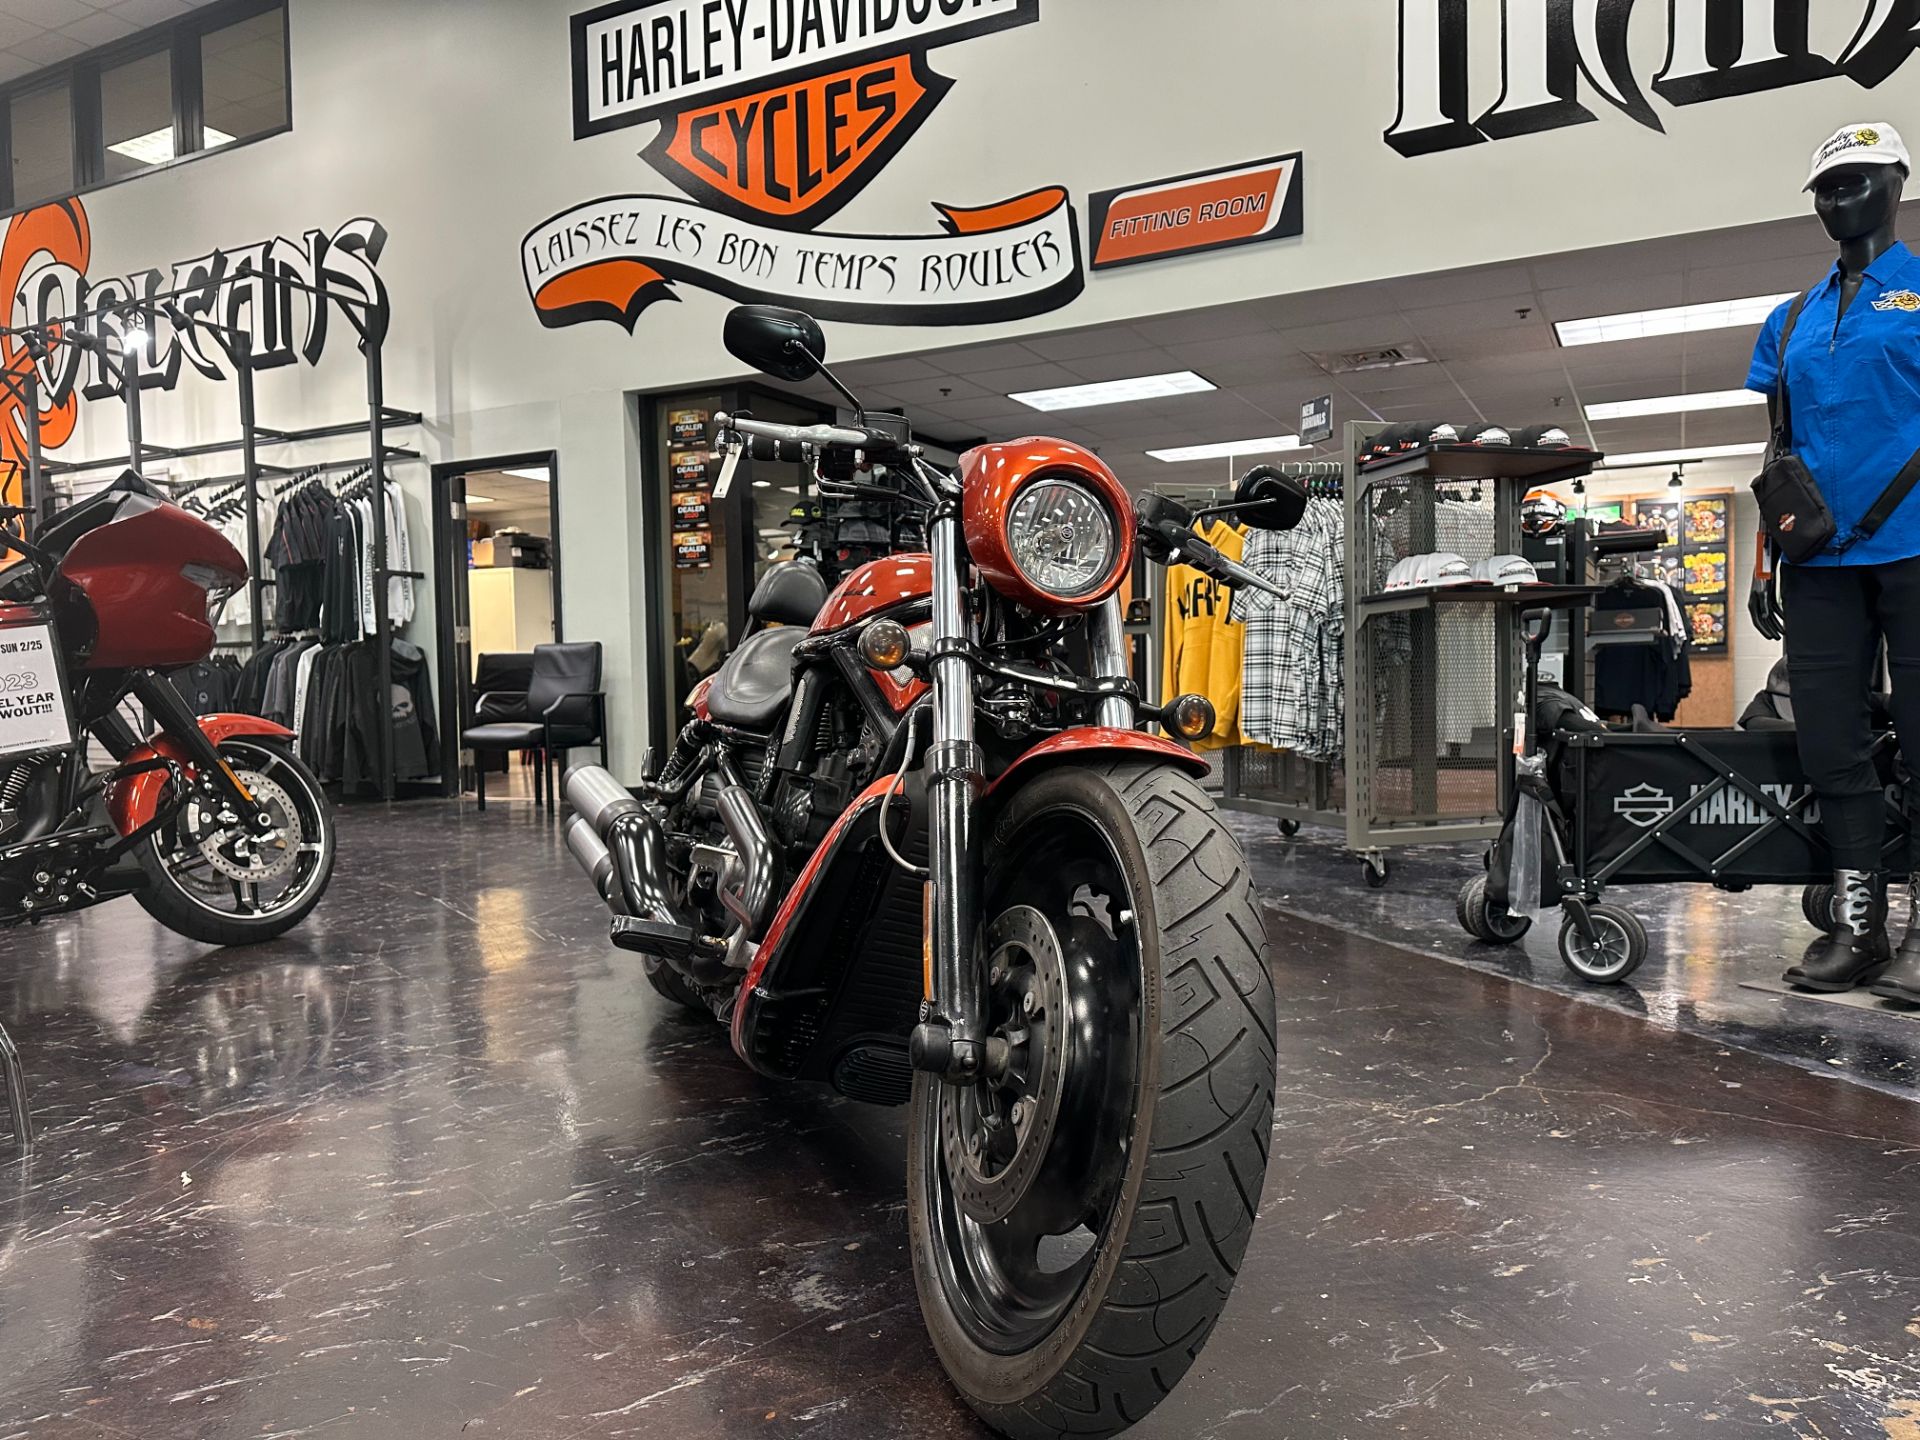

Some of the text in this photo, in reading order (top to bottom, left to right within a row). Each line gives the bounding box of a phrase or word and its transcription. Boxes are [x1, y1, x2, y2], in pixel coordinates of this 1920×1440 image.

[601, 0, 1001, 107] HARLEY-DAV
[690, 66, 896, 203] CYCLES
[1109, 192, 1267, 239] FITTING ROOM
[532, 212, 1060, 294] LAISSEZ LES BON TEMPS ROULER
[12, 216, 389, 408] ORLEANS
[675, 423, 703, 433] DEALER
[677, 464, 705, 474] DEALER
[678, 505, 706, 514] DEALER
[679, 545, 707, 554] DEALER
[0, 640, 42, 654] SUN 2/25
[16, 692, 55, 706] YEAR
